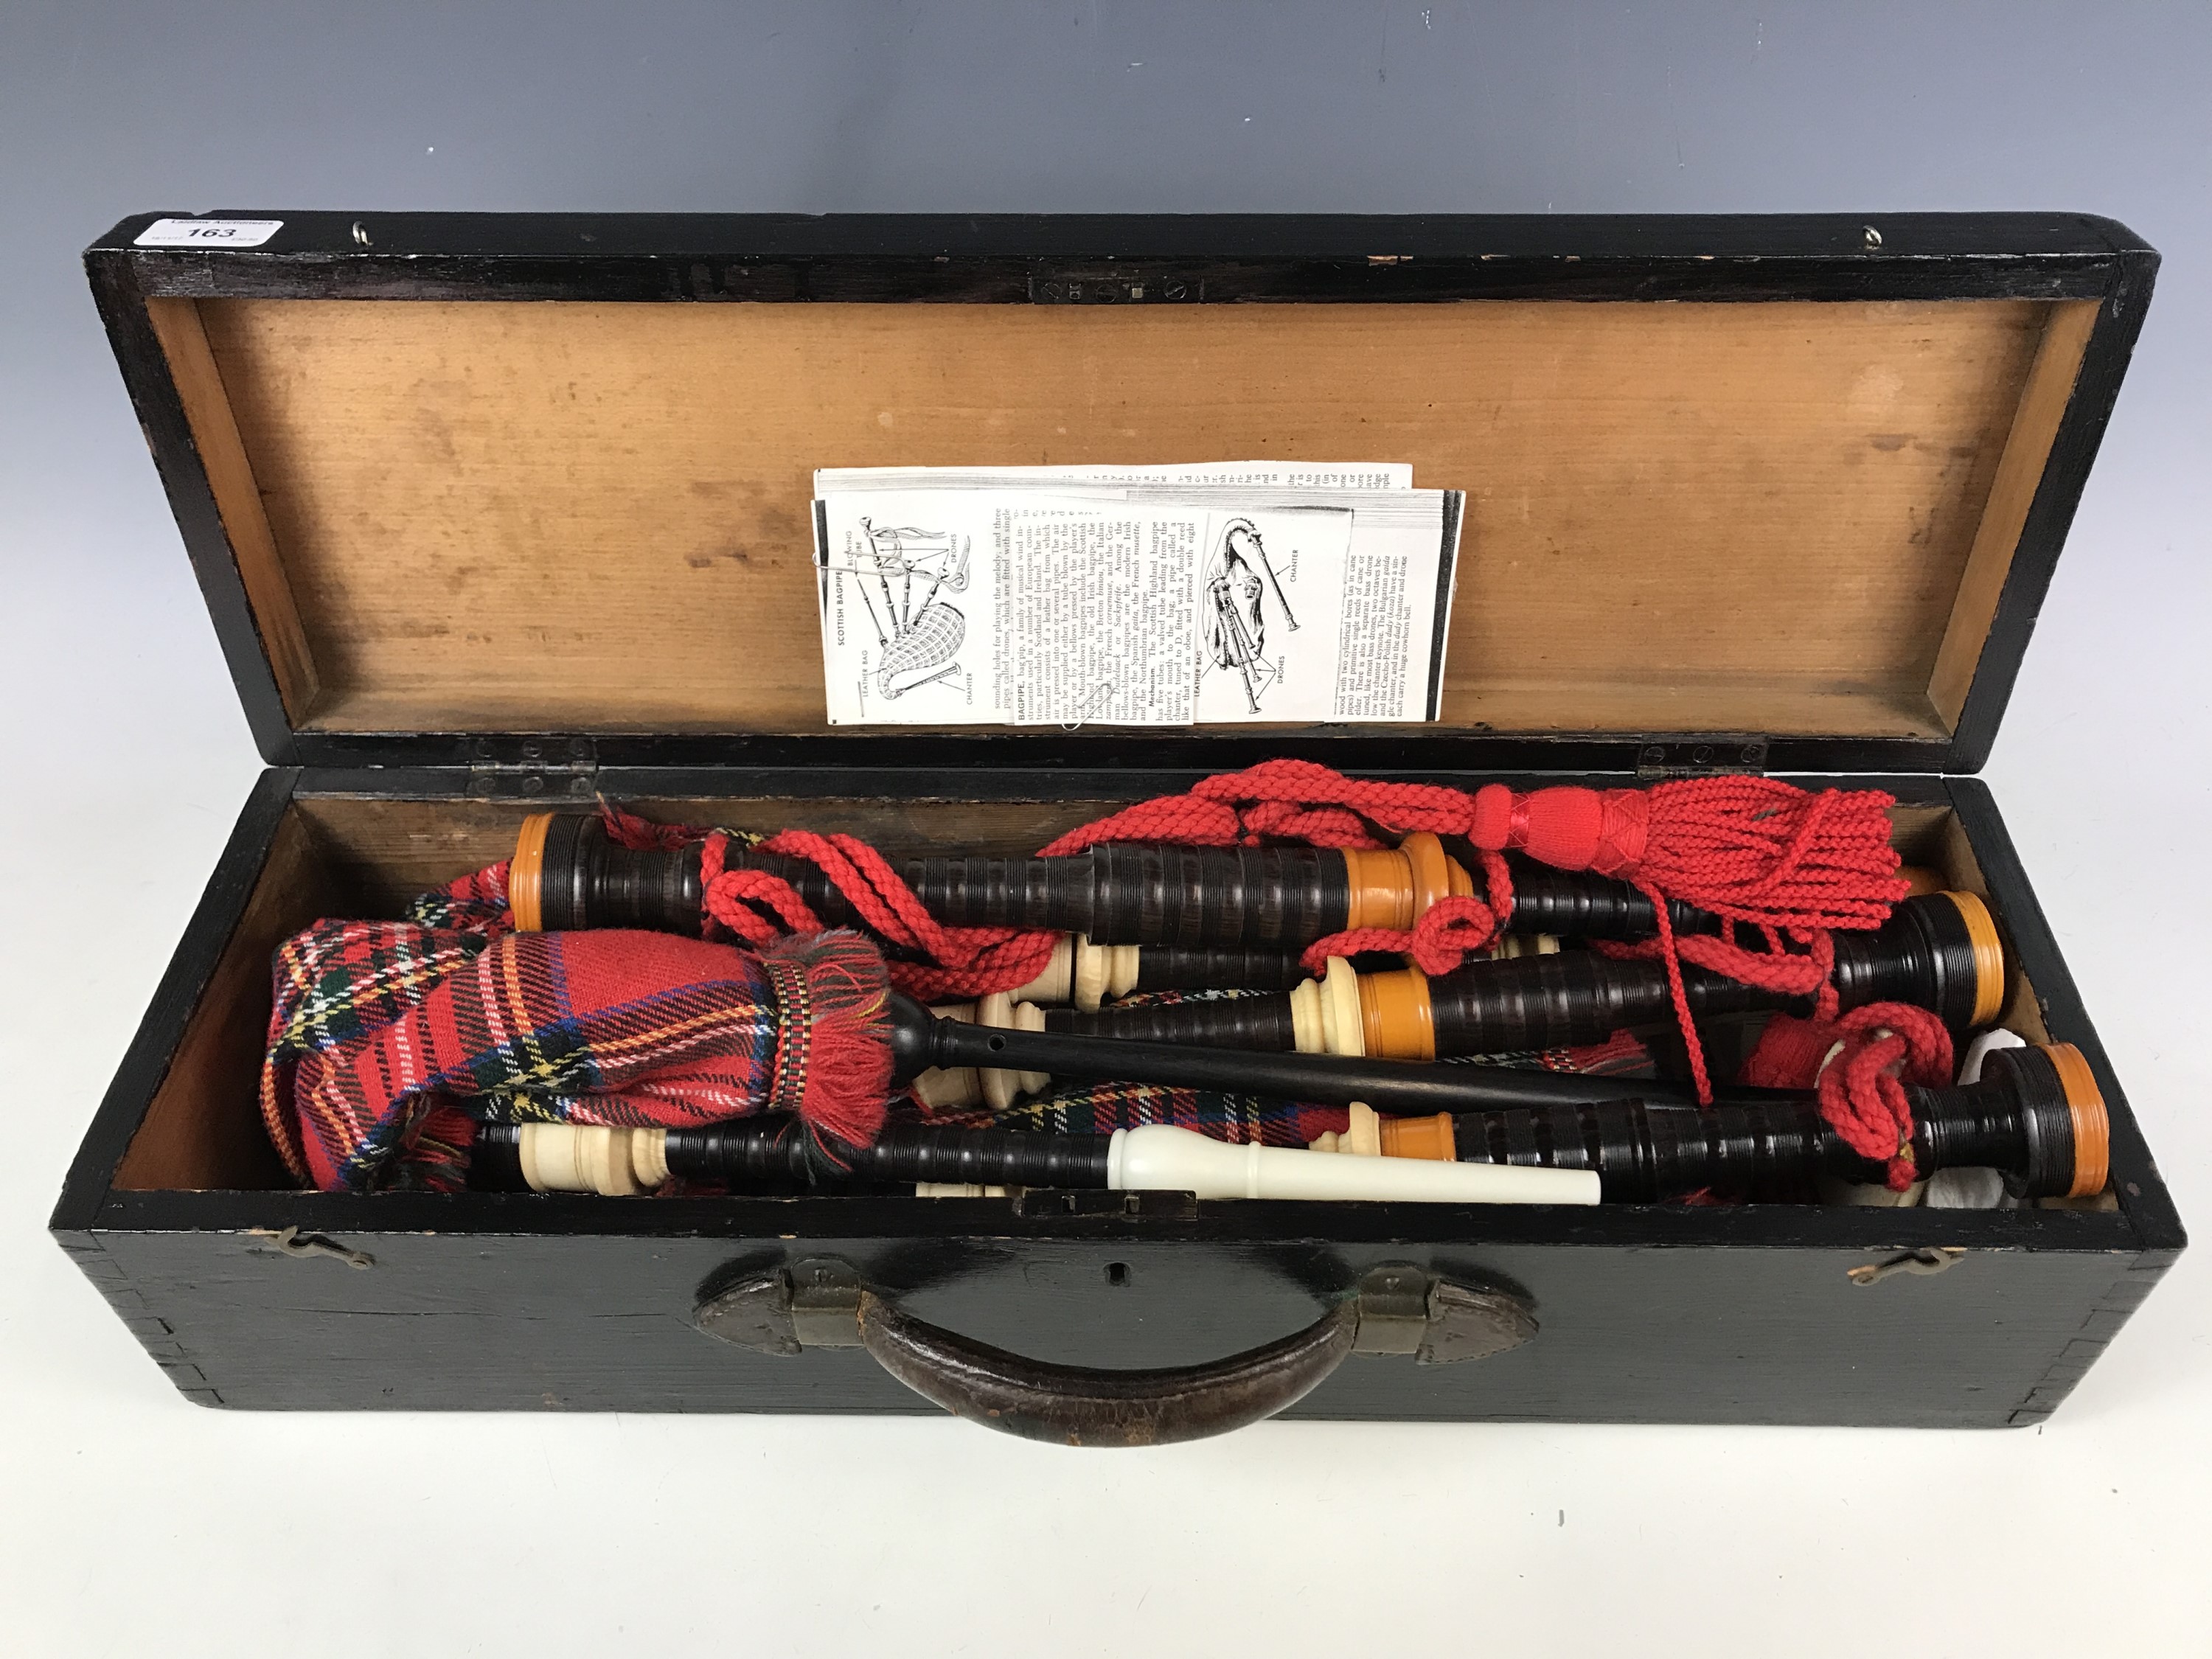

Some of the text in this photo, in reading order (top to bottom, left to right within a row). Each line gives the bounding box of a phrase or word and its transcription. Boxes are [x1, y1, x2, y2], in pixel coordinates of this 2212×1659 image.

[188, 229, 237, 237] 163
[1002, 509, 1012, 533] single
[1114, 521, 1122, 535] the
[1123, 521, 1131, 540] Irish
[1186, 523, 1196, 543] eight
[846, 531, 854, 566] BLOWING
[1069, 524, 1079, 554] player's
[1132, 521, 1141, 555] musette,
[1150, 521, 1160, 554] bagpipe
[1015, 541, 1023, 561] wind
[1114, 543, 1124, 572] Among
[1177, 545, 1185, 573] double
[993, 552, 1003, 584] melody;
[1025, 552, 1034, 590] European
[1131, 560, 1139, 588] French
[1290, 549, 1298, 582] CHANTER
[1043, 578, 1052, 593] bag
[1069, 576, 1079, 586] by
[1122, 584, 1130, 597] the
[1150, 560, 1159, 598] Highland
[1184, 574, 1194, 602] pierced
[1346, 585, 1355, 597] (as
[1016, 597, 1023, 605] of
[1025, 594, 1032, 602] of
[1069, 591, 1079, 619] pressed
[1113, 584, 1124, 627] Sackpfeife.
[1140, 589, 1150, 623] bagpipe.
[1176, 587, 1184, 605] with
[835, 571, 844, 646] SCOTTISH BAGPIPE
[993, 602, 1003, 633] playing
[1016, 608, 1026, 632] family
[1025, 605, 1033, 635] number
[1131, 609, 1141, 631] gaita,
[1175, 610, 1183, 630] fitted
[1344, 599, 1353, 619] bores
[1402, 605, 1411, 620] bell.
[1034, 614, 1042, 647] Scotland
[1043, 638, 1050, 646] of
[1116, 636, 1121, 644] or
[1121, 622, 1132, 657] bagpipes
[1175, 635, 1185, 644] D,
[1183, 629, 1193, 650] oboe,
[1342, 622, 1353, 658] cylindrical
[1363, 555, 1380, 716] tuned, like most bass drones, two octaves be-
[1371, 555, 1391, 716] low the chanter keynote. The Bulgarian gaida
[1400, 622, 1410, 653] cowhorn
[1002, 629, 1012, 657] drones,
[1026, 647, 1033, 655] in
[1130, 635, 1140, 666] Spanish
[1148, 641, 1156, 658] The
[1175, 649, 1183, 658] to
[1043, 650, 1051, 681] consists
[1139, 628, 1147, 684] Northumbrian
[1185, 656, 1191, 667] an
[1340, 660, 1349, 674] two
[1399, 654, 1409, 672] huge
[1034, 651, 1044, 697] particularly
[1069, 667, 1079, 678] by
[1183, 672, 1190, 680] of
[1277, 655, 1285, 684] DRONES
[992, 673, 1002, 709] sounding
[1071, 682, 1077, 690] or
[1138, 689, 1147, 702] the
[1147, 666, 1155, 707] Mechanism.
[1182, 685, 1190, 701] that
[1340, 677, 1348, 692] with
[1398, 680, 1407, 699] carry
[1002, 688, 1011, 709] pipes
[1017, 681, 1026, 720] BAGPIPE,
[1034, 700, 1044, 720] tries,
[1043, 685, 1051, 720] strument
[1069, 695, 1079, 719] player
[1130, 687, 1139, 720] bagpipe,
[1173, 689, 1183, 721] chanter,
[1338, 695, 1346, 715] wood
[1395, 700, 1403, 717] each
